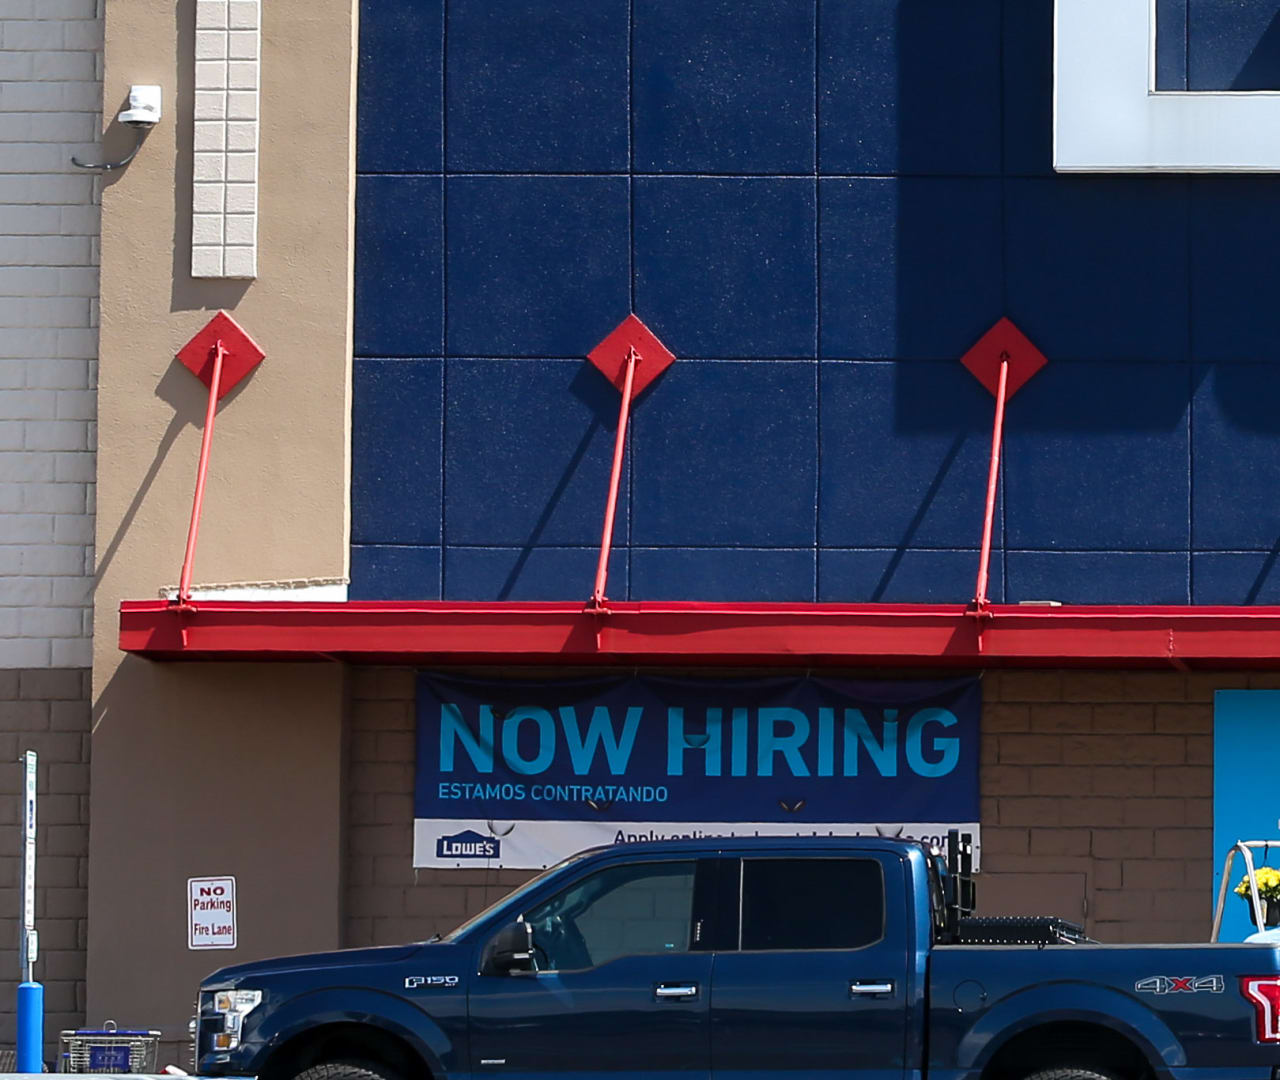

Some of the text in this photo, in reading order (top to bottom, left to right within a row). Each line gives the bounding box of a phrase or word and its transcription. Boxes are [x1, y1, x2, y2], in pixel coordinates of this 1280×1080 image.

[439, 703, 961, 778] NOW HIRING
[438, 783, 668, 802] ESTAMOS CONTRATANDO
[442, 840, 494, 856] LOWE'S
[199, 886, 225, 896] NO
[194, 898, 231, 912] Parking
[194, 923, 232, 936] Fire Lane
